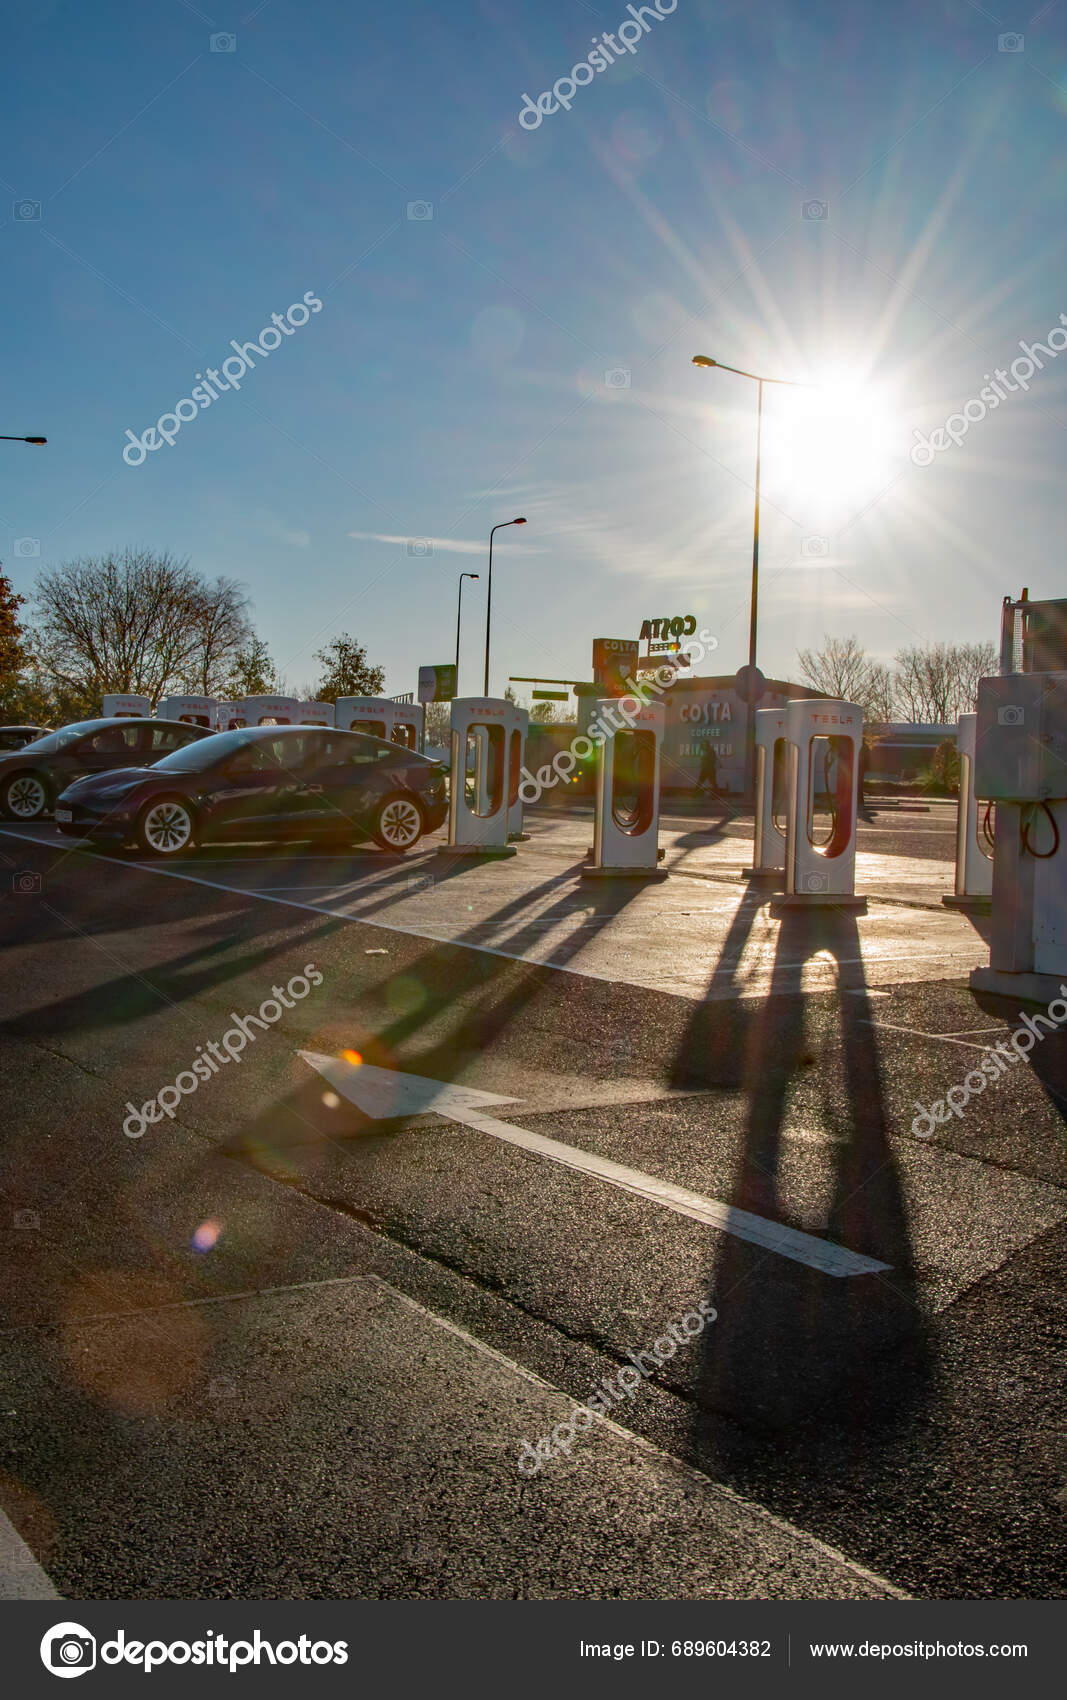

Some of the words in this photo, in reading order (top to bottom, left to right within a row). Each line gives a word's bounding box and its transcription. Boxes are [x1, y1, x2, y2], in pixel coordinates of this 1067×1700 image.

[603, 640, 638, 653] COSTA
[470, 707, 506, 717] TESLA
[679, 702, 732, 725] COSTA
[811, 713, 853, 724] TESLA
[689, 728, 721, 737] COFFEE
